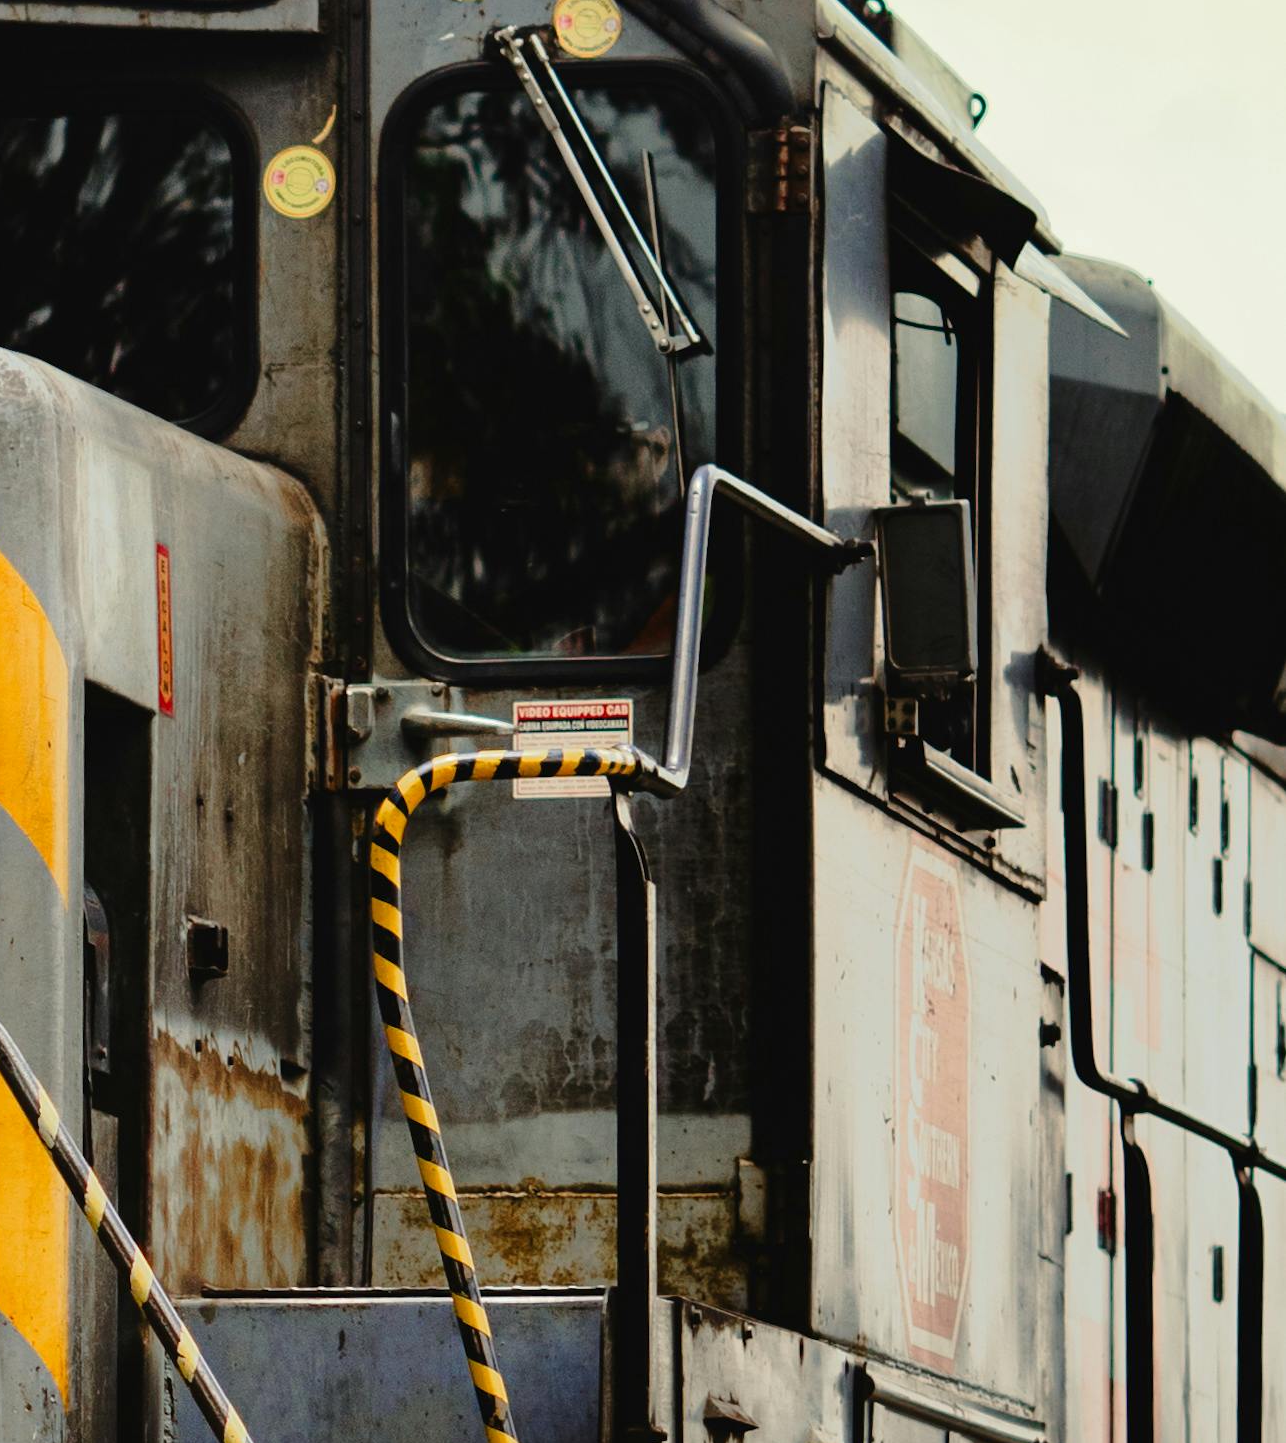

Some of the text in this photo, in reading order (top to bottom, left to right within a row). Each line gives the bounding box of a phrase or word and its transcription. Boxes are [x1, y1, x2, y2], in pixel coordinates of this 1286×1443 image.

[518, 703, 628, 718] VIDEO EQUIPPED CAB
